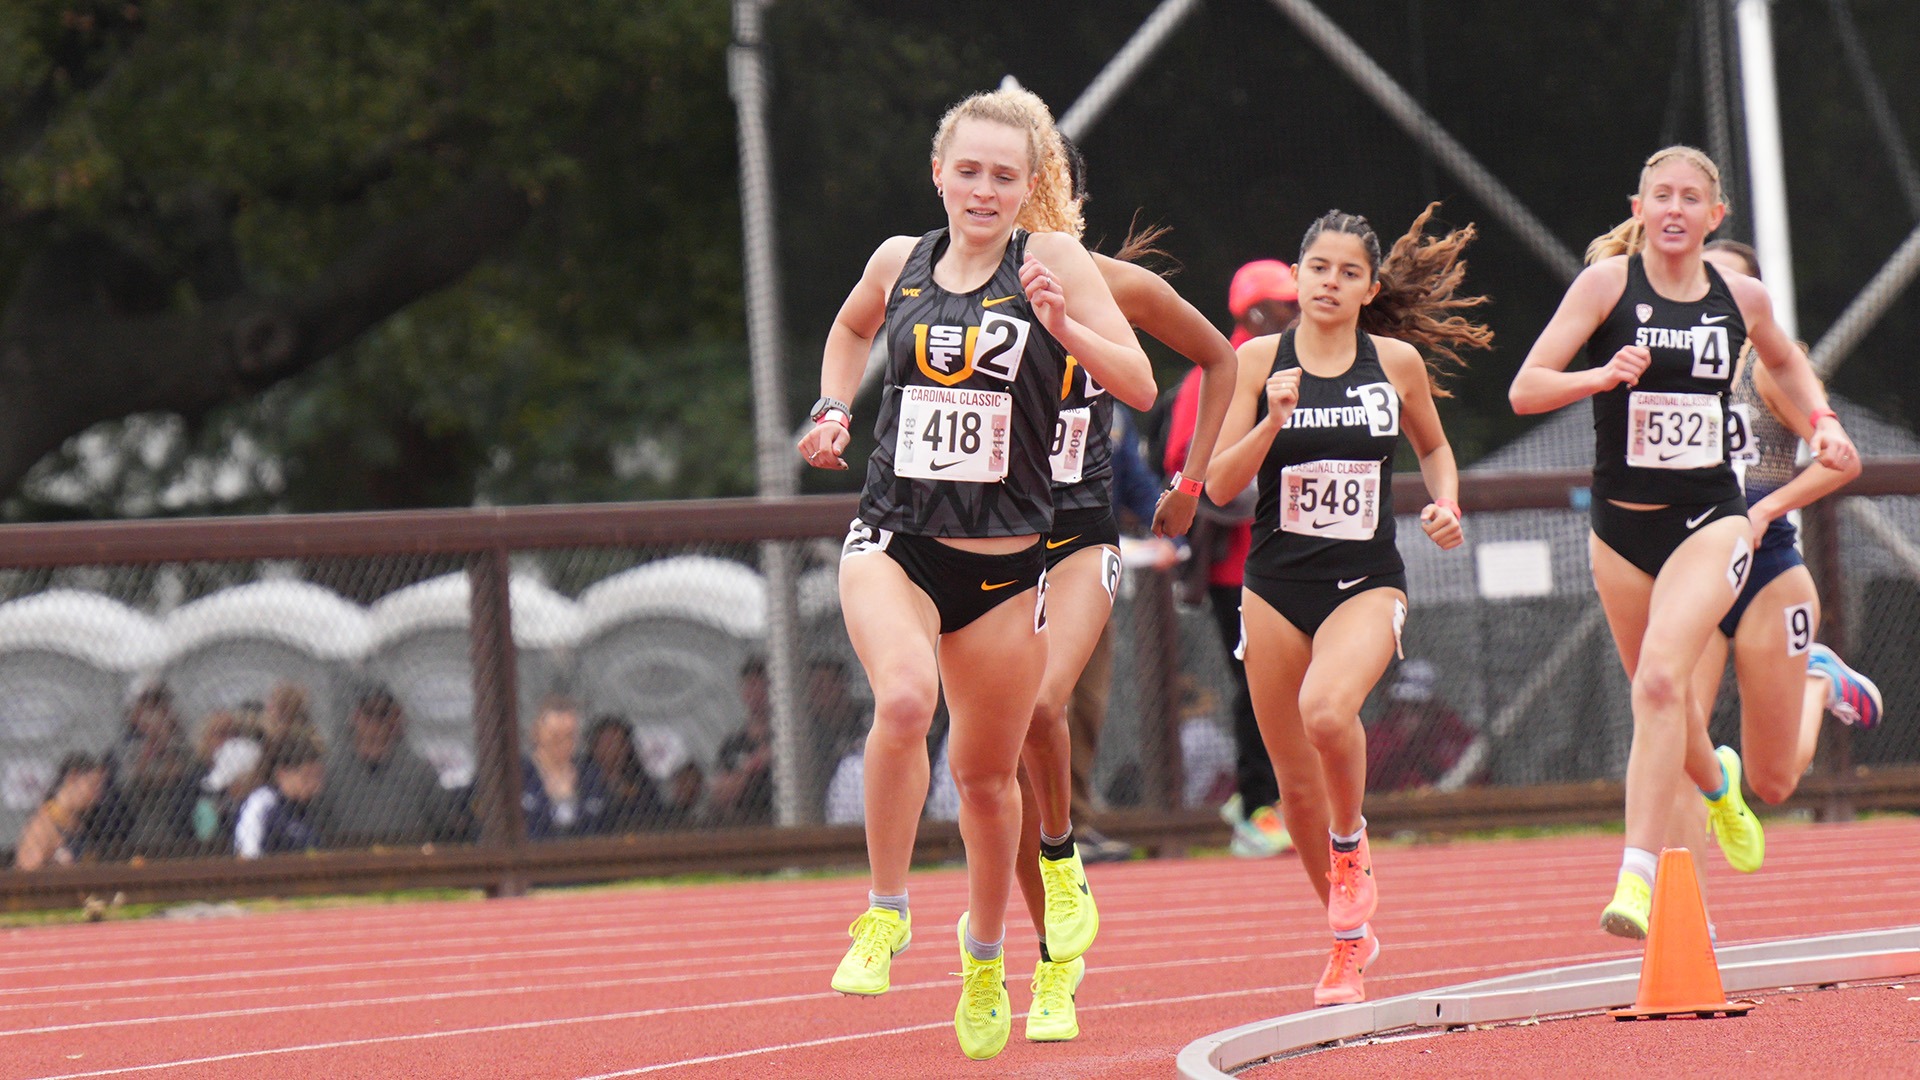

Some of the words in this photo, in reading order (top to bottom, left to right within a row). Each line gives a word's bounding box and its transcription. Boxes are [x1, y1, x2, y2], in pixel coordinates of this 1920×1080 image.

[977, 319, 1019, 376] 2
[1635, 327, 1694, 350] STANF
[1699, 331, 1724, 374] 4
[911, 388, 957, 404] CARDINAL
[959, 391, 1002, 407] CLASSIC
[1368, 386, 1393, 432] 3
[903, 417, 916, 450] 418
[922, 409, 982, 454] 418
[1281, 405, 1369, 429] TANFOR
[1648, 411, 1703, 446] 532
[992, 427, 1005, 460] 418
[1068, 429, 1083, 459] 409
[1337, 463, 1373, 474] CLASSIC
[1300, 477, 1360, 516] 548
[1365, 489, 1374, 517] 548
[1733, 552, 1748, 589] 4
[1792, 608, 1809, 650] 9
